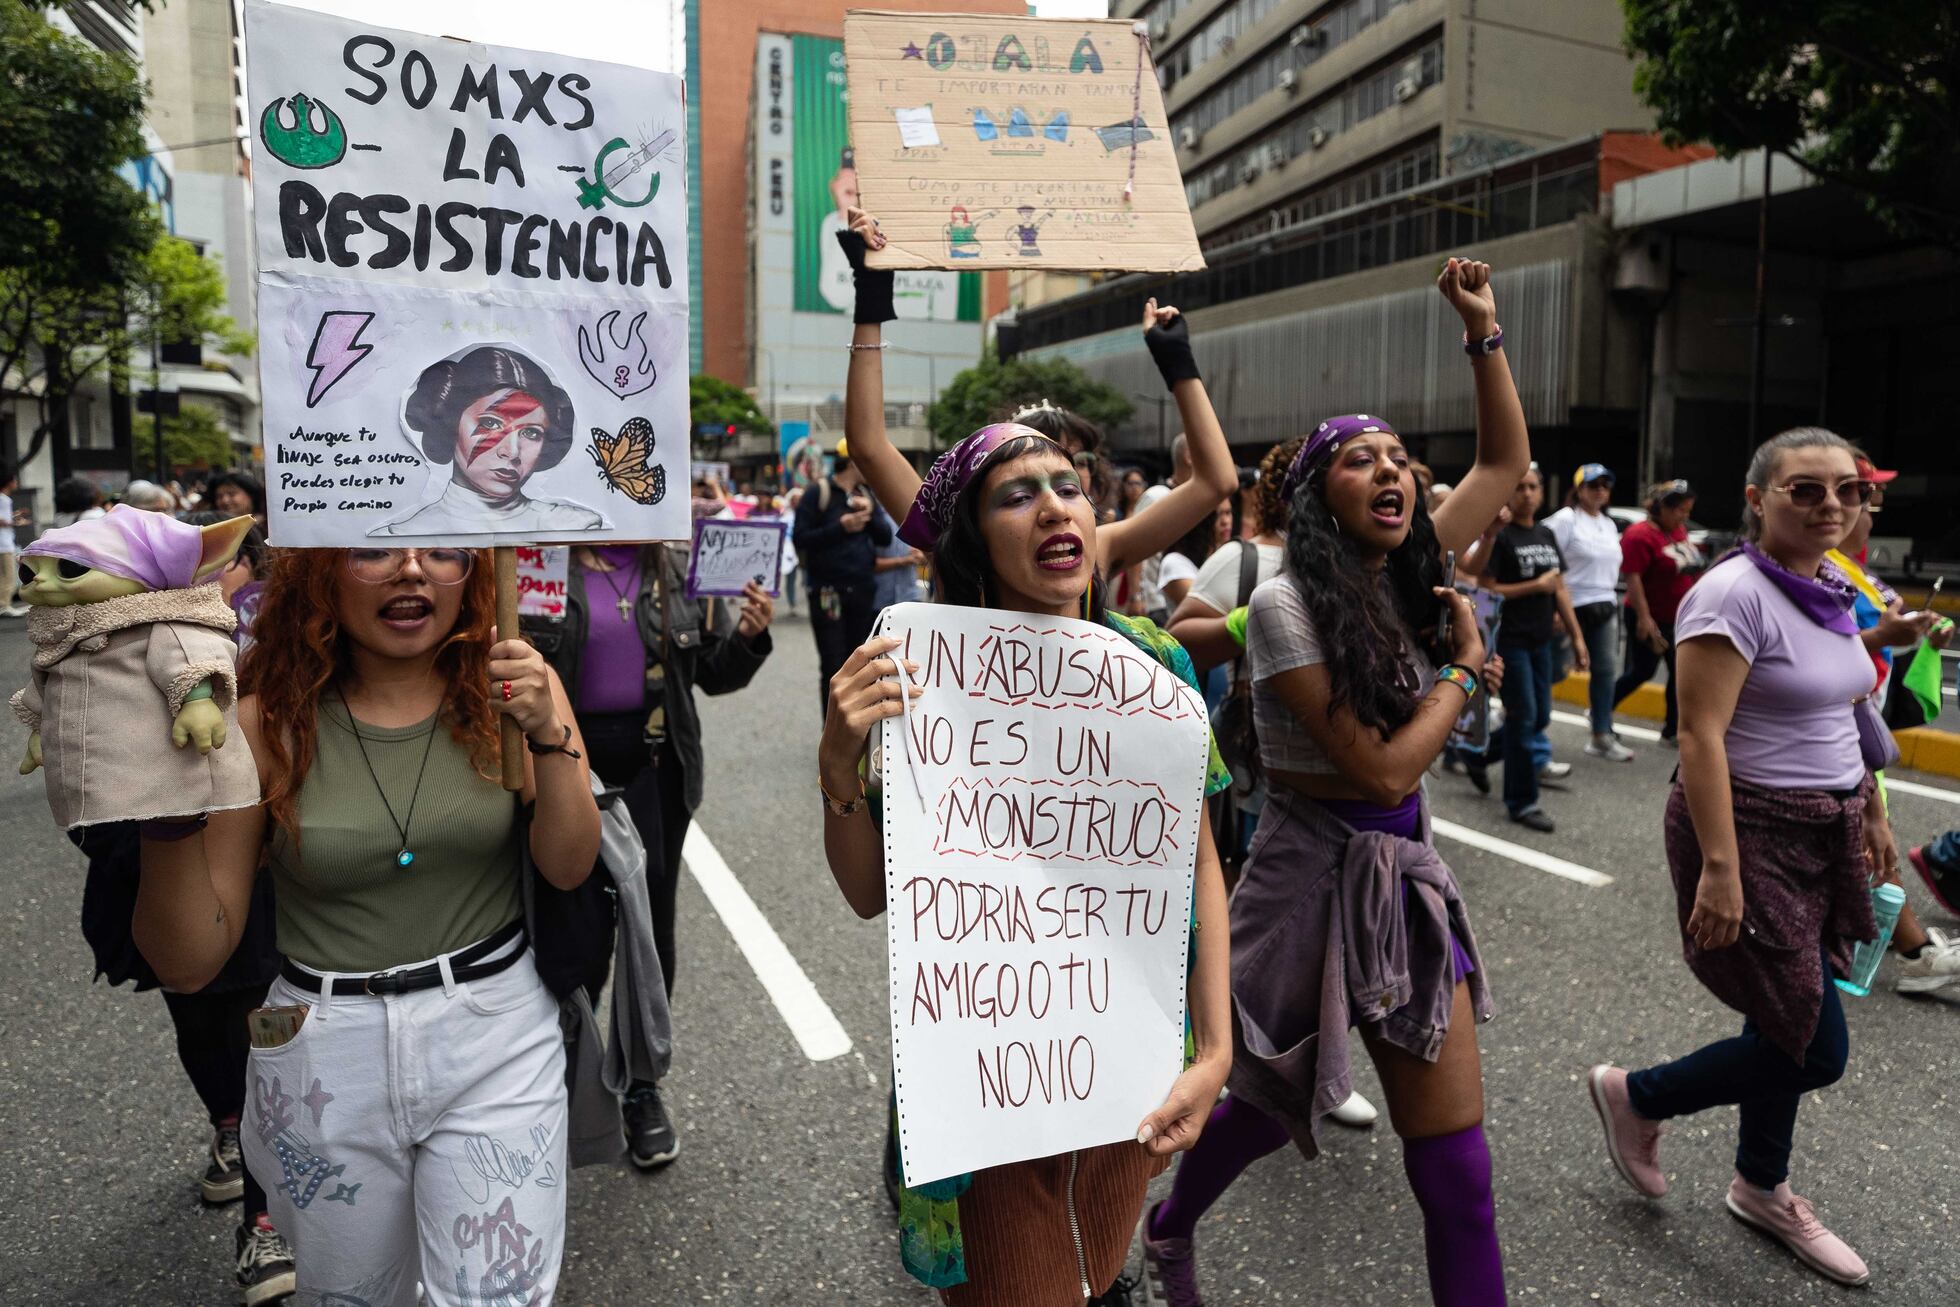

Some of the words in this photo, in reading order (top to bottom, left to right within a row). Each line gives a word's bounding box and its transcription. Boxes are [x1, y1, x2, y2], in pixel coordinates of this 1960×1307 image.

[343, 35, 595, 131] SOMXS
[769, 47, 783, 135] CENTRO
[876, 78, 905, 93] TE
[443, 127, 525, 188] LA
[279, 180, 672, 289] RESISTENCIA
[906, 628, 965, 690] UN
[983, 636, 1204, 720] ABUSADOR
[907, 714, 953, 765] NO
[970, 719, 1029, 766] ES
[1056, 726, 1111, 777] UN
[944, 789, 1166, 859] MONSTRUO
[1116, 883, 1168, 937] TU
[1058, 952, 1109, 1014] TU
[977, 1034, 1095, 1109] NOVIO
